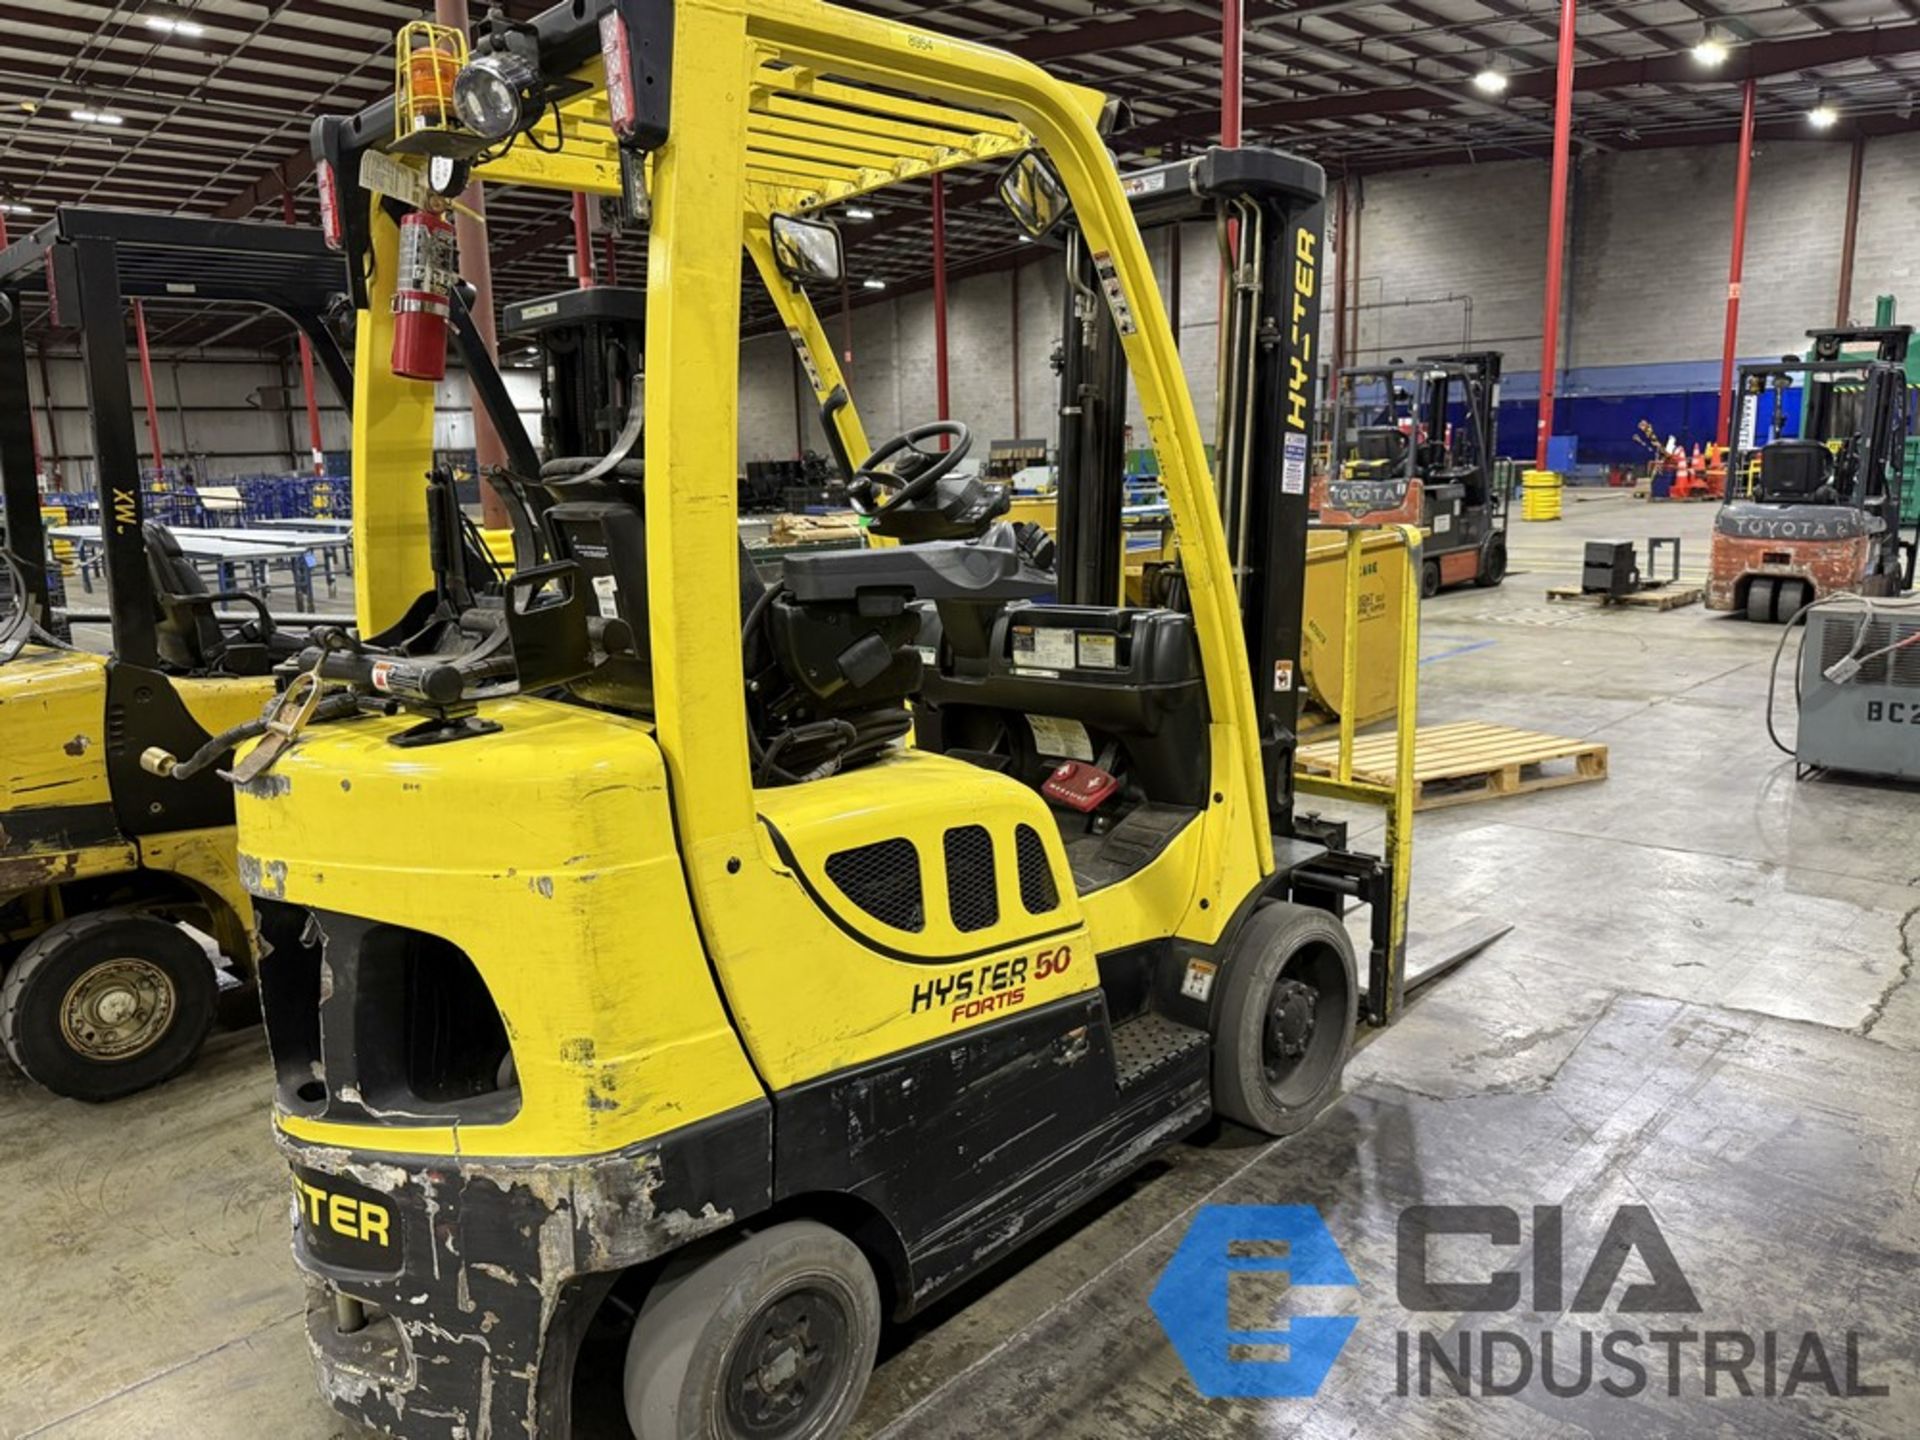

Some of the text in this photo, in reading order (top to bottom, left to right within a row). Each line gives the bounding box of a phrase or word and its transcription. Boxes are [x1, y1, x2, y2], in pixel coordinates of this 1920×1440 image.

[1736, 519, 1828, 538] TOYOTA
[911, 945, 1071, 1014] HYSTER 50
[952, 986, 1026, 1023] FORTIS
